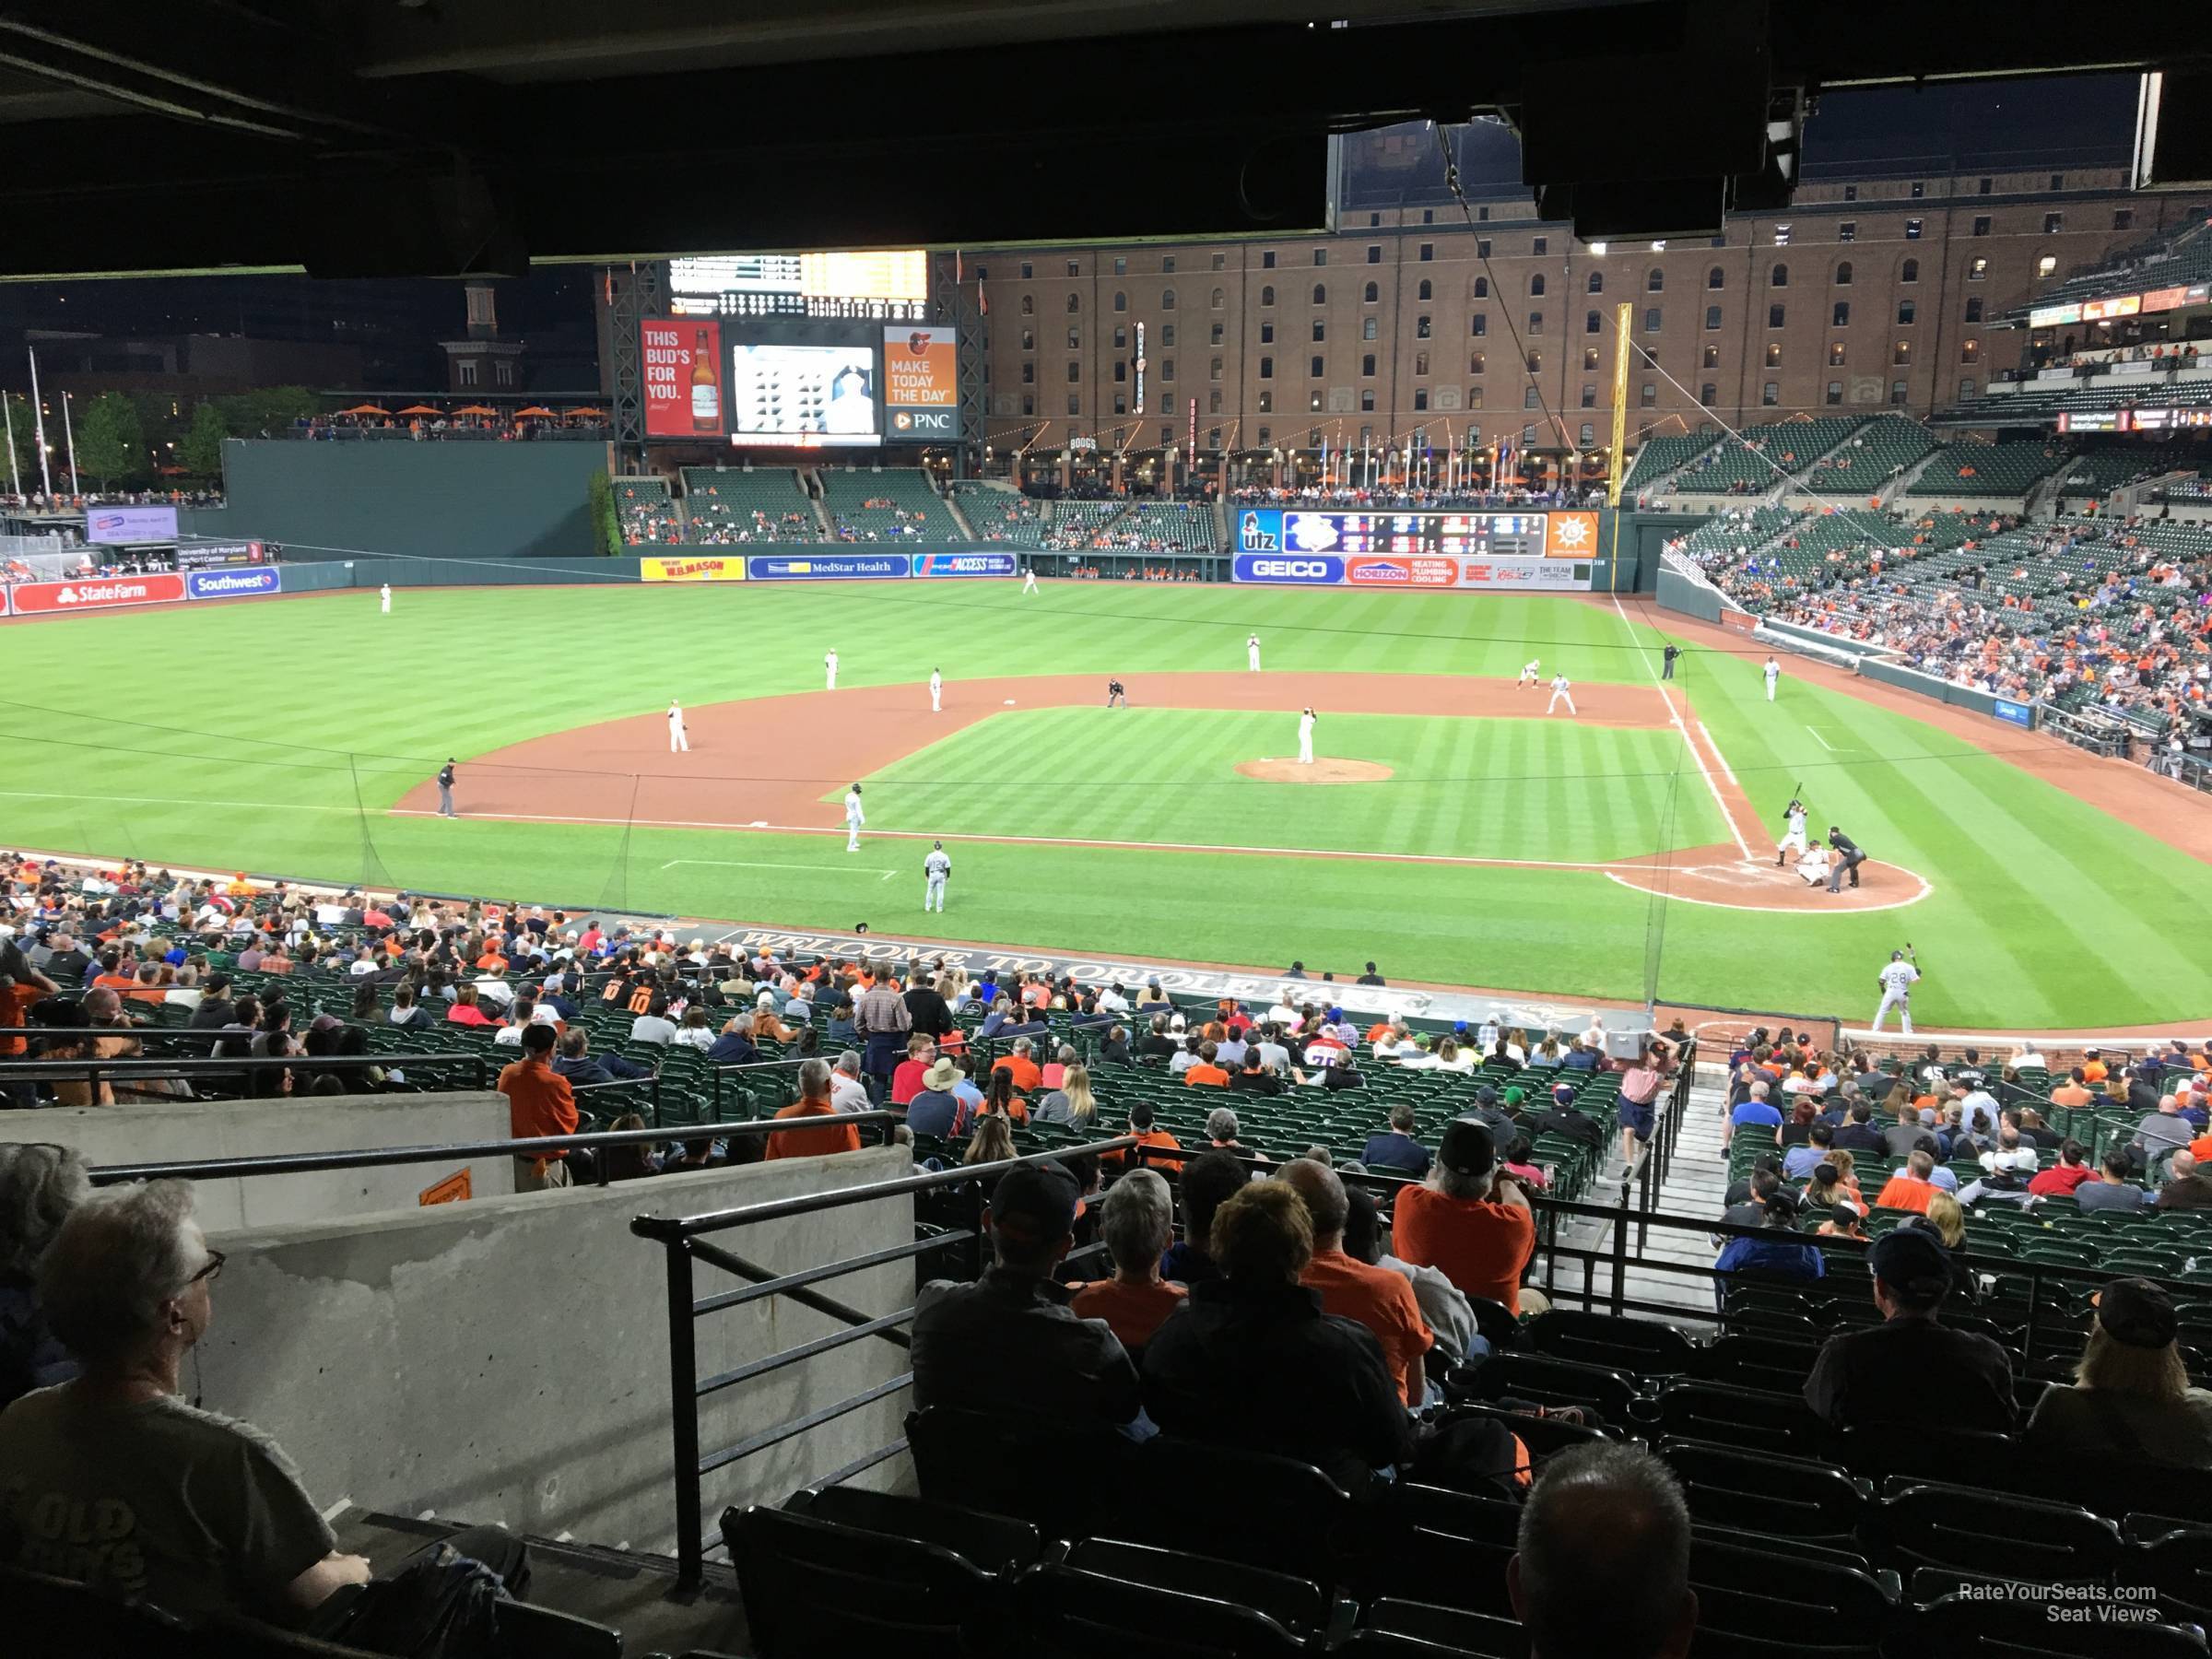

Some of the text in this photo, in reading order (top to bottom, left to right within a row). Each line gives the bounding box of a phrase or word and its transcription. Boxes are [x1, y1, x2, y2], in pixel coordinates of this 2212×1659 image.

[645, 331, 678, 347] THIS
[647, 349, 690, 364] BUD'S
[891, 360, 931, 373] MAKE
[647, 367, 676, 382] FOR
[891, 374, 934, 387] TODAY
[648, 384, 681, 399] YOU.
[891, 389, 918, 402] THE
[913, 413, 951, 429] PNC
[813, 561, 891, 572] MedStar Health
[956, 557, 988, 571] ACCESS
[1252, 559, 1327, 578] GEICO
[1411, 559, 1447, 568] HEATING
[1539, 566, 1571, 575] THE TEAM
[1354, 569, 1407, 580] HORIZON
[1411, 568, 1453, 576] PLUMBING
[198, 574, 264, 592] Southwest
[741, 931, 973, 966] WELCOME
[982, 954, 1053, 973] TO
[1890, 972, 1907, 983] 28
[602, 983, 620, 1001] 10
[628, 993, 651, 1015] 10
[1923, 1065, 1944, 1080] 45
[30, 1491, 136, 1543] OLD
